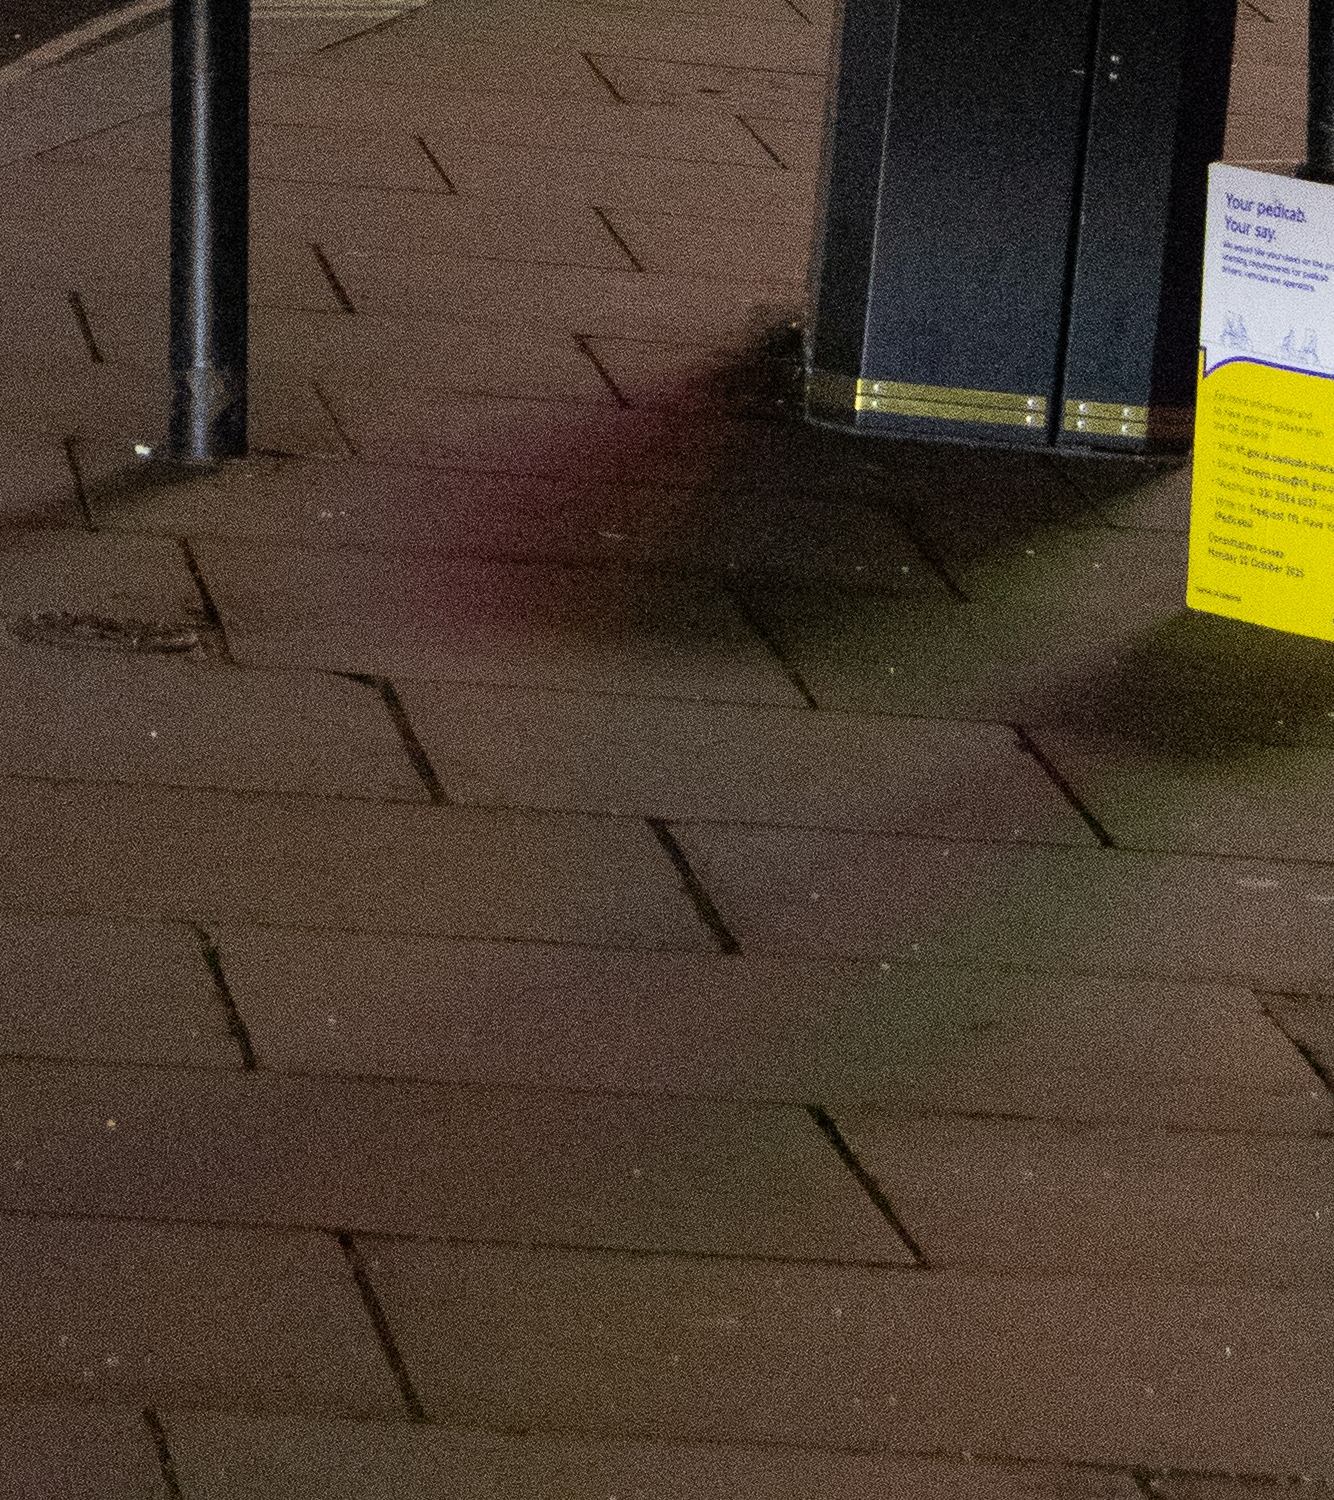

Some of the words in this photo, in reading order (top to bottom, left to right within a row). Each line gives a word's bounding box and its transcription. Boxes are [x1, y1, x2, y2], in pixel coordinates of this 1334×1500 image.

[1224, 191, 1254, 214] Your
[1255, 199, 1307, 226] pedicab.
[1222, 213, 1251, 236] Your
[1253, 224, 1277, 244] say.
